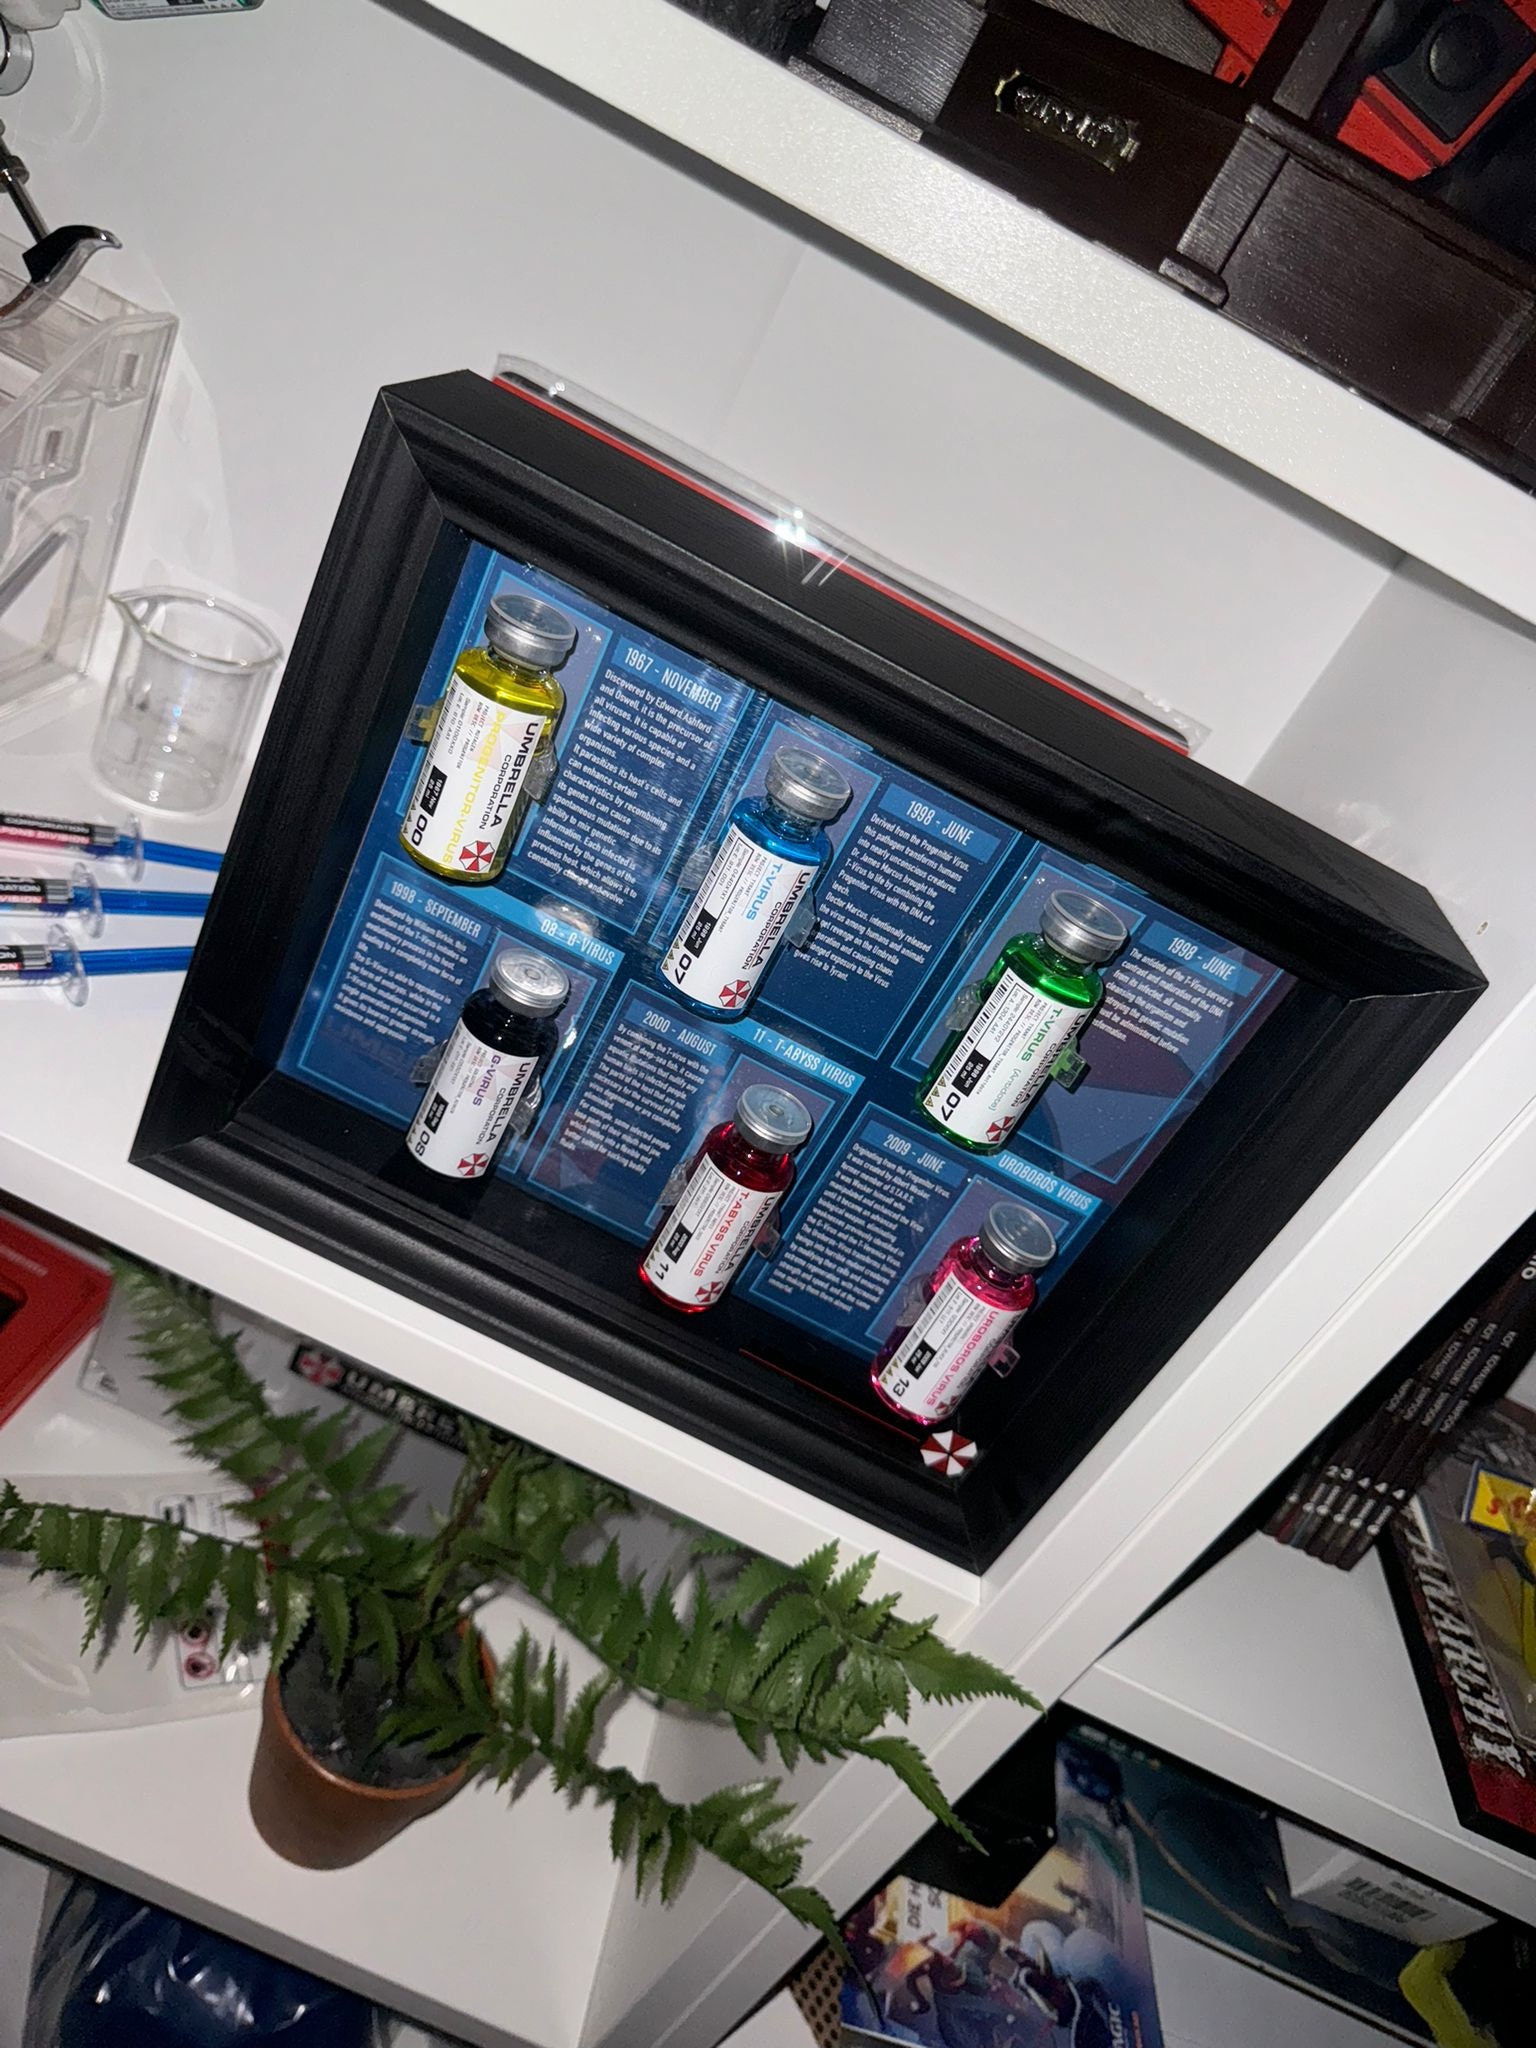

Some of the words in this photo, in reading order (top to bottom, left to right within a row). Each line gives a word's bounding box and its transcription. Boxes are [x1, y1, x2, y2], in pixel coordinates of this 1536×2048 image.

[604, 669, 646, 698] Discovered
[644, 690, 656, 704] by
[654, 696, 684, 719] Edward
[682, 709, 713, 734] Ashford
[623, 646, 654, 674] 1967
[652, 664, 661, 677] -
[660, 667, 722, 711] NOVEMBER
[588, 706, 621, 731] infecting
[620, 724, 648, 745] various
[647, 739, 676, 760] species
[675, 753, 691, 767] and
[689, 761, 696, 771] a
[592, 695, 605, 707] all
[603, 700, 633, 722] viruses.
[633, 715, 641, 726] It
[639, 718, 648, 730] is
[647, 724, 677, 745] capable
[676, 739, 686, 750] of
[598, 682, 615, 697] and
[640, 703, 648, 715] it
[646, 707, 655, 719] is
[654, 711, 668, 726] the
[667, 719, 704, 744] precursor
[702, 737, 714, 750] of
[478, 753, 512, 830] CORPORATION
[489, 722, 538, 828] UMBRELLA
[567, 756, 582, 769] can
[582, 764, 613, 785] enhance
[612, 780, 638, 798] certain
[869, 813, 896, 833] Derived
[893, 825, 910, 841] from
[908, 833, 921, 846] the
[919, 839, 953, 862] Progenitor
[905, 799, 935, 825] 1998
[934, 816, 942, 829] -
[941, 819, 974, 846] JUNE
[745, 861, 782, 921] T-VIRUS
[856, 836, 870, 849] into
[869, 843, 890, 860] nearly
[888, 853, 927, 879] unconscious
[926, 873, 957, 895] creatures.
[390, 880, 416, 904] 1998
[416, 895, 423, 906] -
[424, 898, 481, 937] SEPTEMBER
[740, 900, 782, 971] CORPORATION
[751, 871, 810, 967] UMBRELLA
[824, 891, 846, 909] Doctor
[868, 914, 905, 940] intentionally
[903, 933, 932, 953] released
[540, 917, 558, 937] 08
[566, 931, 614, 965] G-VIRUS
[672, 953, 692, 984] 07
[693, 936, 703, 949] Jun
[1167, 936, 1198, 961] 1998
[1195, 952, 1204, 965] -
[1201, 955, 1236, 981] JUNE
[1129, 947, 1142, 960] The
[1140, 955, 1167, 972] antidote
[1165, 967, 1175, 976] of
[1172, 970, 1185, 982] the
[1205, 988, 1228, 1004] serves
[1226, 999, 1234, 1007] a
[642, 1010, 670, 1033] 2000
[670, 1026, 677, 1035] -
[676, 1028, 717, 1057] AUGUST
[655, 1042, 666, 1053] the
[686, 1058, 699, 1070] with
[698, 1064, 709, 1075] the
[752, 1027, 766, 1043] 11
[765, 1035, 773, 1045] -
[774, 1038, 821, 1071] T-ABYSS
[820, 1061, 855, 1088] VIRUS
[1020, 1007, 1062, 1063] T-VIRUS
[1020, 1015, 1085, 1103] UMBRELLA
[471, 1054, 501, 1107] G-VIRUS
[485, 1062, 530, 1141] UMBRELLA
[963, 1076, 974, 1088] Jun
[987, 1067, 1022, 1111] (Antidote)
[1010, 1042, 1056, 1107] CORPORATION
[475, 1086, 506, 1145] CORPORATION
[938, 1091, 961, 1121] 07
[882, 1133, 911, 1156] 2009
[909, 1148, 917, 1158] -
[916, 1151, 945, 1173] JUNE
[997, 1154, 1058, 1193] UROBOROS
[1056, 1184, 1092, 1210] VIRUS
[713, 1191, 749, 1242] T-ABYSS
[723, 1197, 774, 1270] UMBRELLA
[654, 1261, 670, 1280] 11
[693, 1243, 719, 1277] VIRUS
[949, 1310, 997, 1373] UROBOROS
[891, 1377, 910, 1397] 13
[925, 1375, 953, 1406] VIRUS
